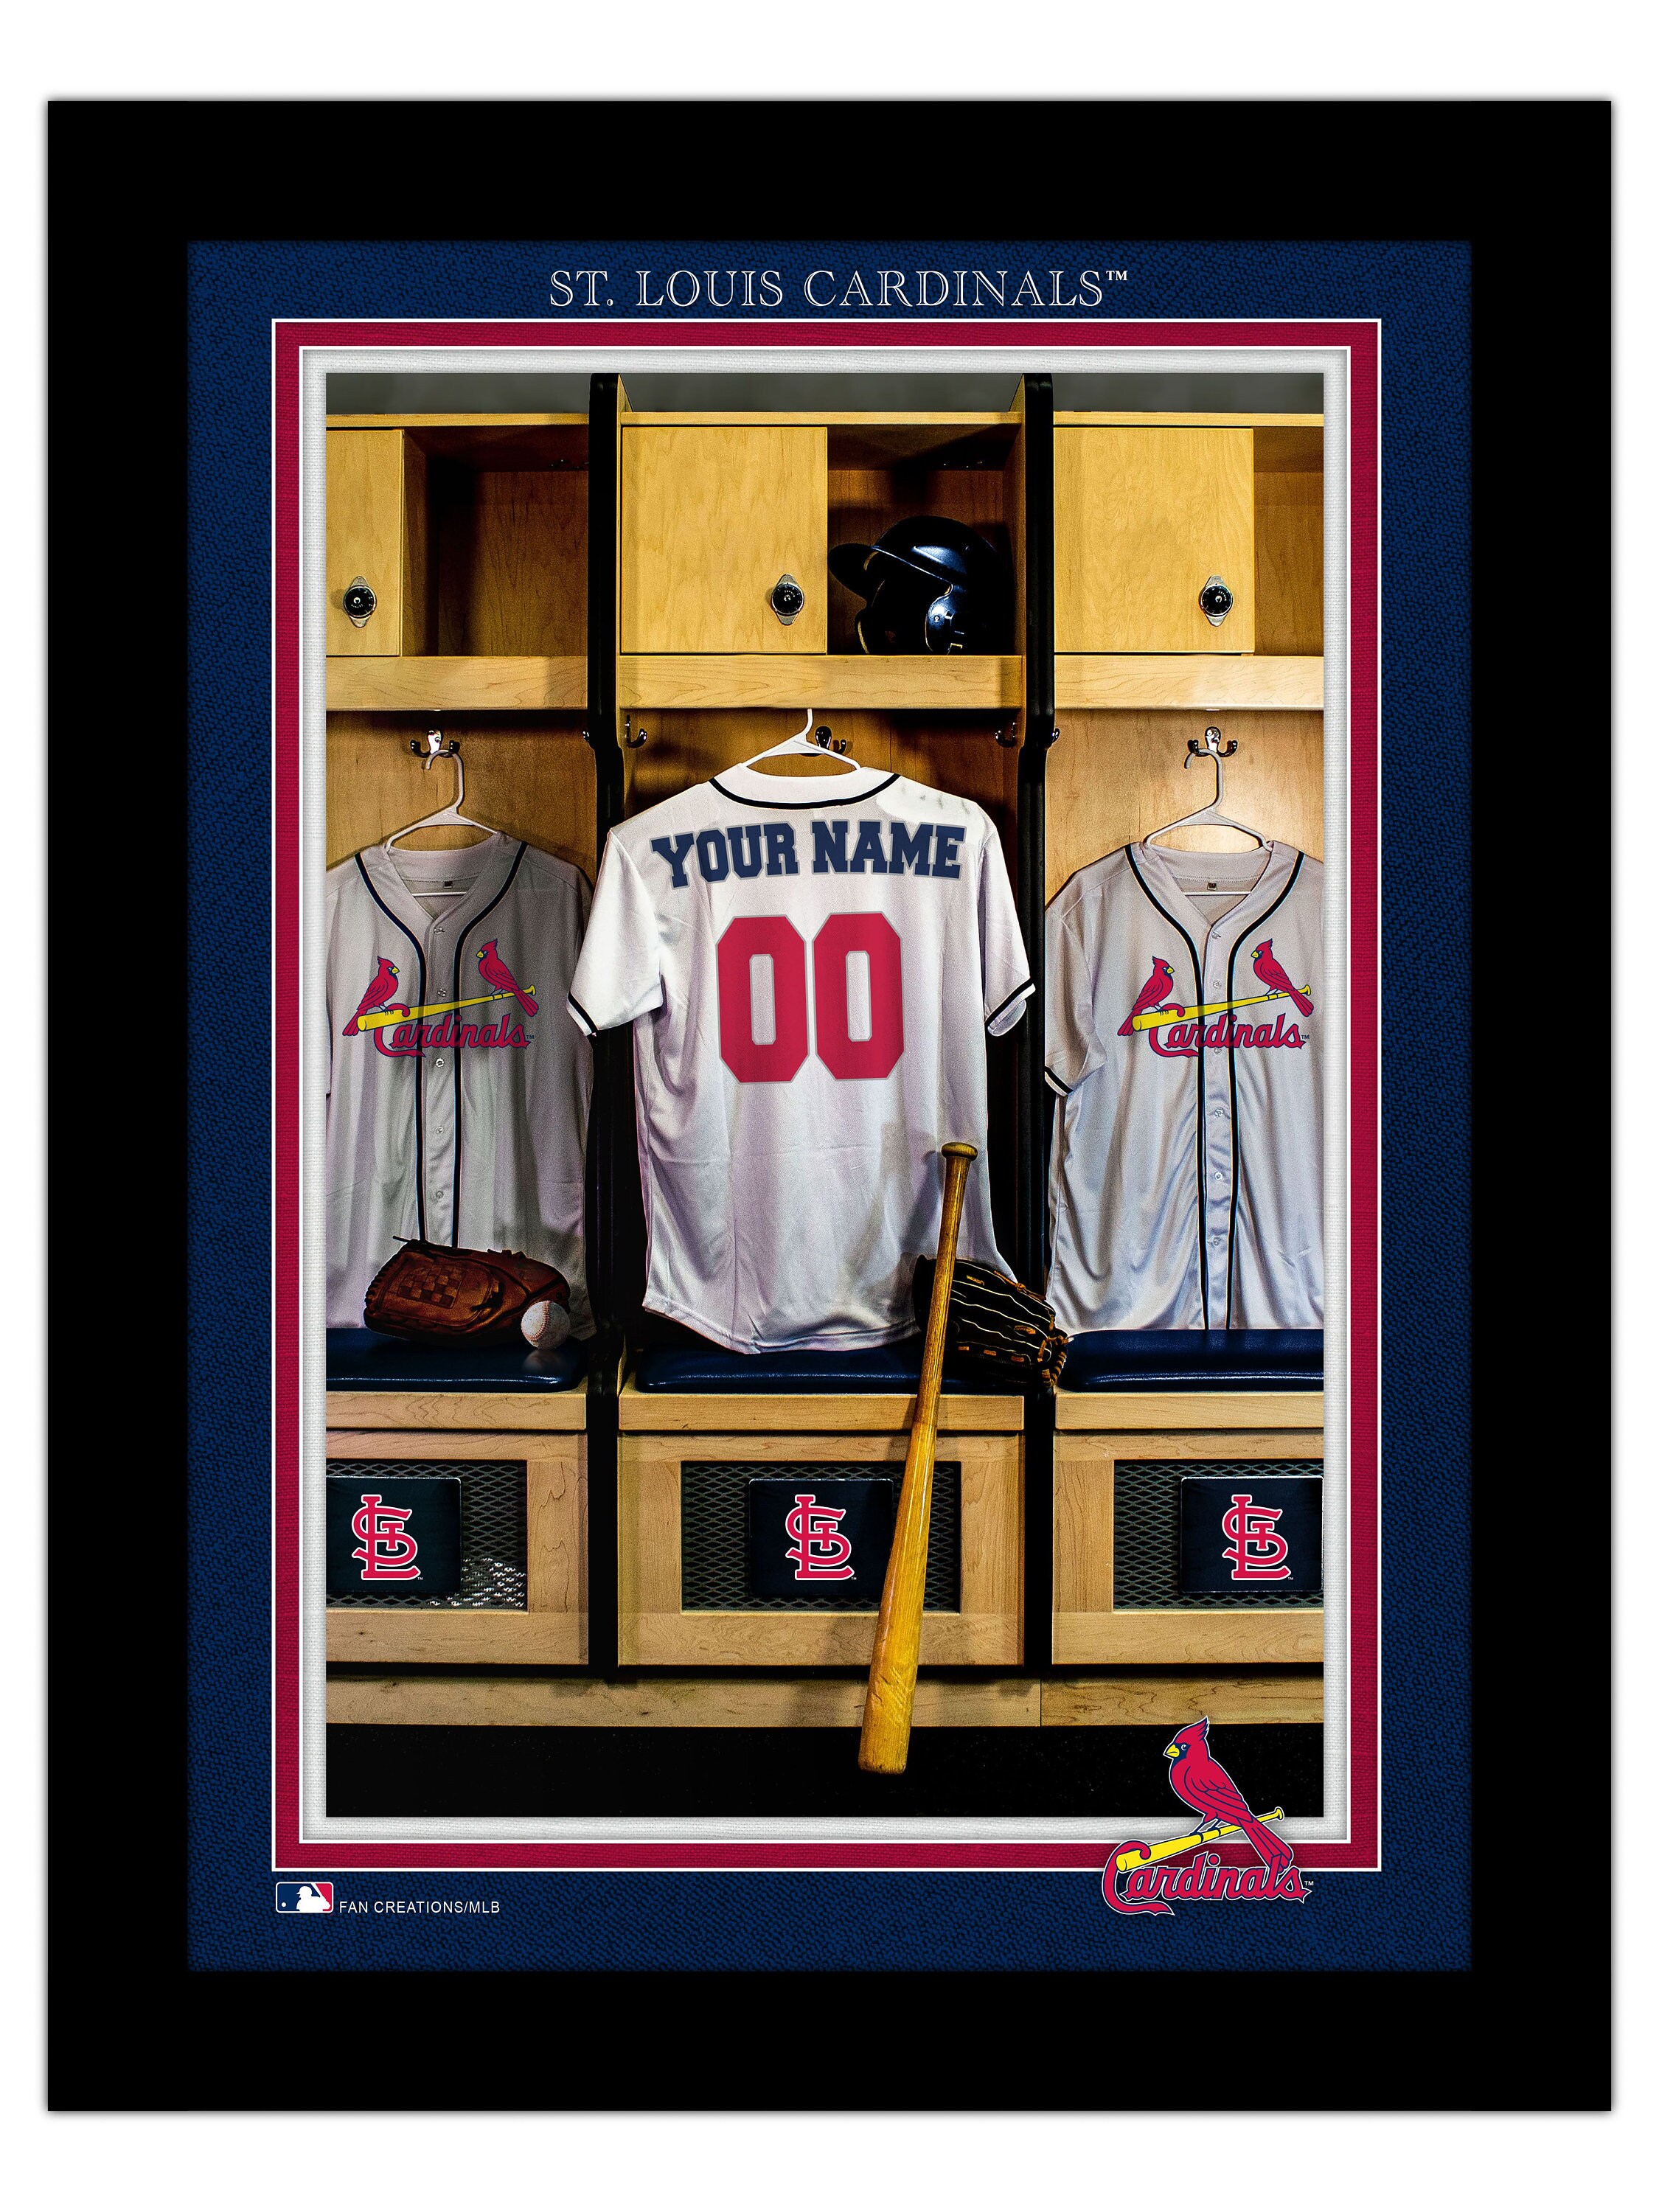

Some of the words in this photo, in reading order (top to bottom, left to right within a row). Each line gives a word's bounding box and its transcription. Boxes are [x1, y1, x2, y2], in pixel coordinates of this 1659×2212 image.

[549, 270, 613, 307] ST.
[636, 270, 783, 307] LOUIS
[650, 821, 800, 889] YOUR
[809, 819, 967, 880] NAME
[715, 911, 905, 1085] 00
[373, 1003, 531, 1058] Cardinals
[1148, 1003, 1307, 1058] Cardinals
[1102, 1840, 1312, 1916] Cardinals
[338, 1901, 369, 1914] FAN
[374, 1901, 501, 1914] CREATIONS/MLB
